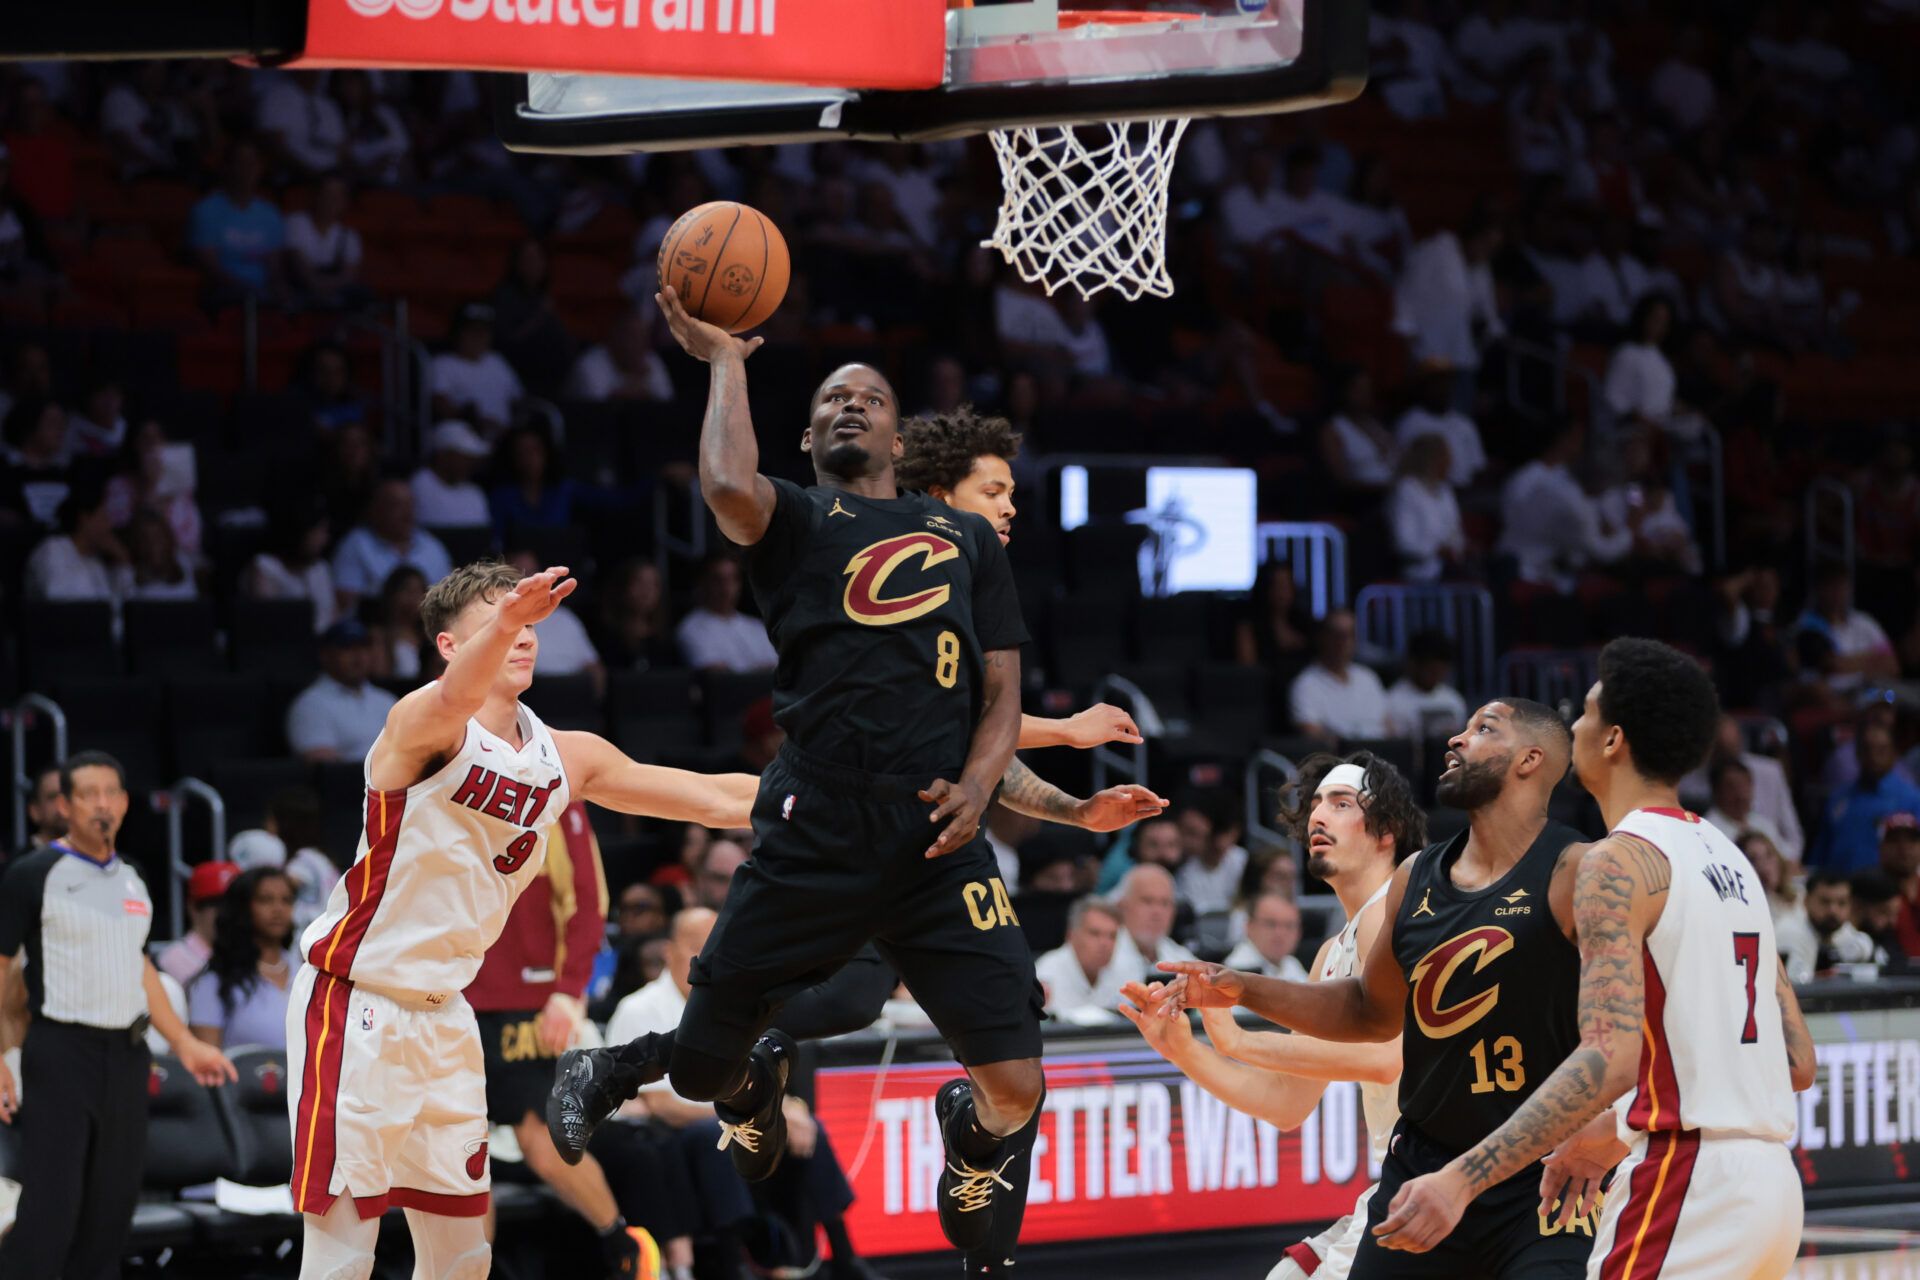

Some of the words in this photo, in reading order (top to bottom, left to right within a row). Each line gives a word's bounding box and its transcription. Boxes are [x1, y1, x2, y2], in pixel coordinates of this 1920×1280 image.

[936, 629, 961, 689] 8
[451, 764, 561, 828] HEAT
[493, 830, 538, 875] 9
[1494, 905, 1531, 917] CLIFFS
[1701, 862, 1749, 906] WARE
[1732, 932, 1760, 1044] 7
[1470, 1035, 1526, 1094] 13
[1788, 1040, 1920, 1150] ETTER
[875, 1097, 941, 1216] TH
[1027, 1082, 1174, 1204] ETTER
